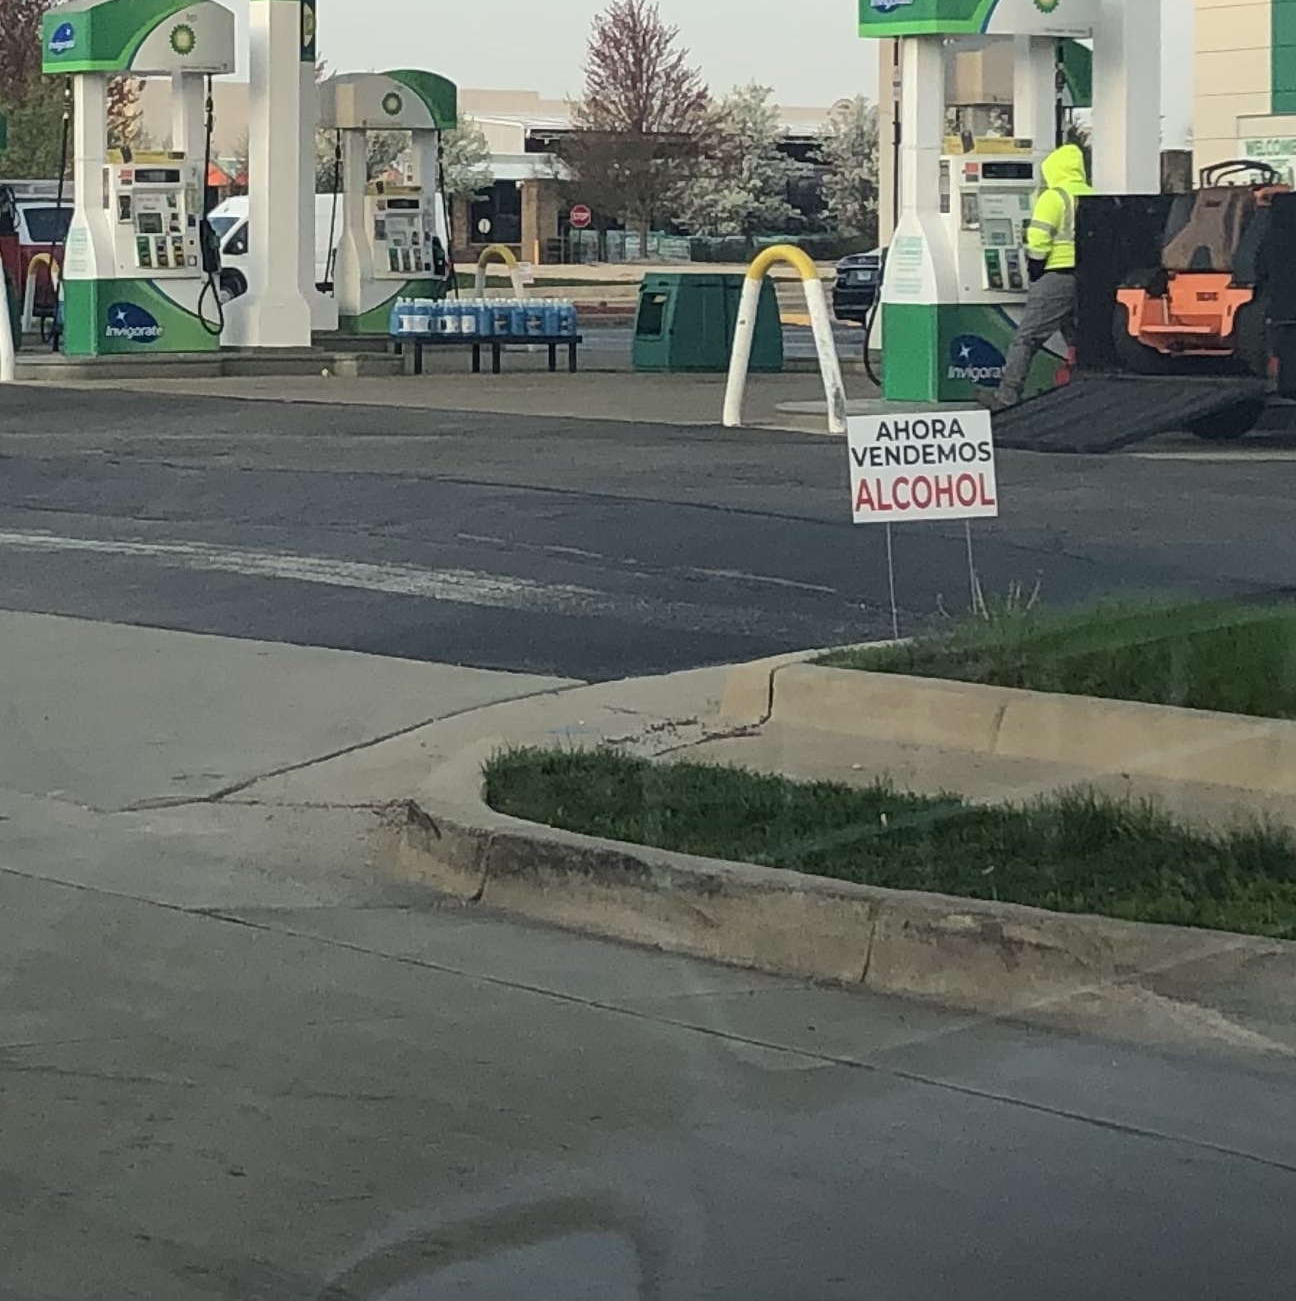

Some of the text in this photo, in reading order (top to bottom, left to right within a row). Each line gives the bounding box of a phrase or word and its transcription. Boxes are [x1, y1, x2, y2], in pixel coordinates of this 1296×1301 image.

[105, 325, 164, 339] Invigorate
[876, 418, 965, 442] AHORA
[851, 441, 992, 467] VENDEMOS
[855, 473, 995, 512] ALCOHOL
